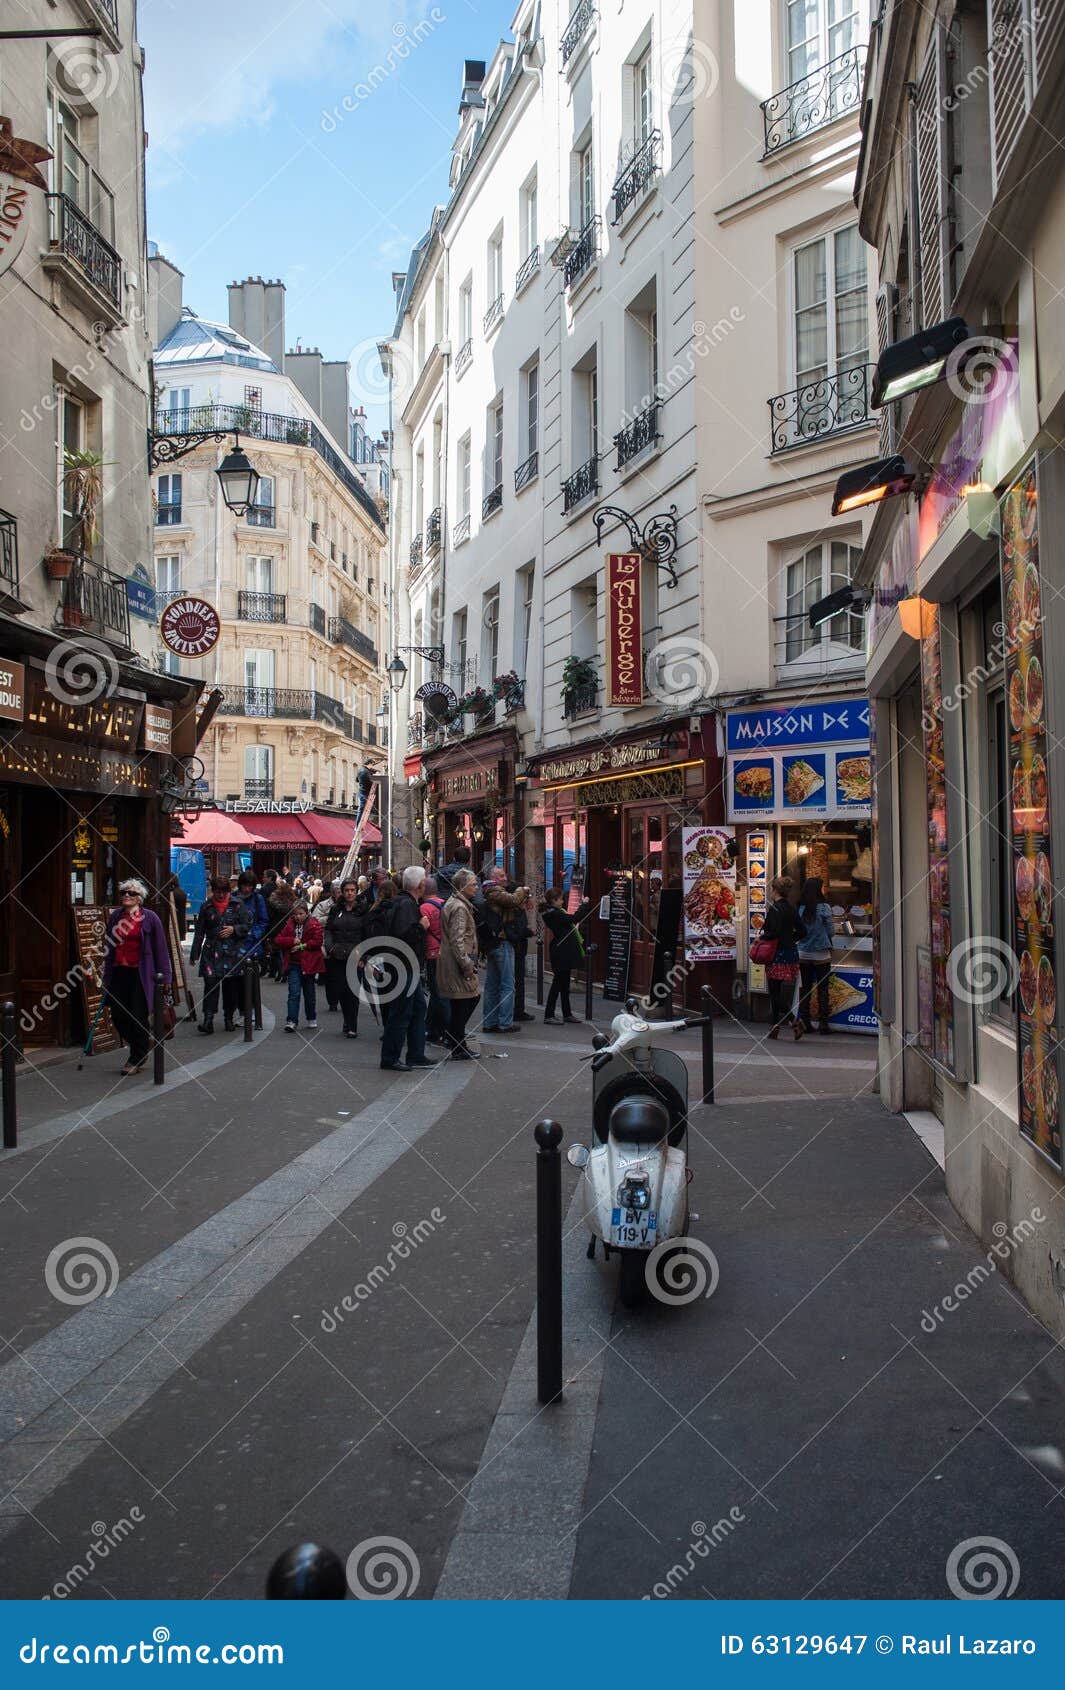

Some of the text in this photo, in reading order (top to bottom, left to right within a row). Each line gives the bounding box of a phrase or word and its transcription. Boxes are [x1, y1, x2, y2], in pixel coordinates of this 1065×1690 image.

[165, 600, 215, 625] FONDUES
[164, 626, 218, 655] RACLETTES
[735, 716, 813, 740] MAISON
[822, 709, 849, 731] DE
[858, 977, 874, 988] EX
